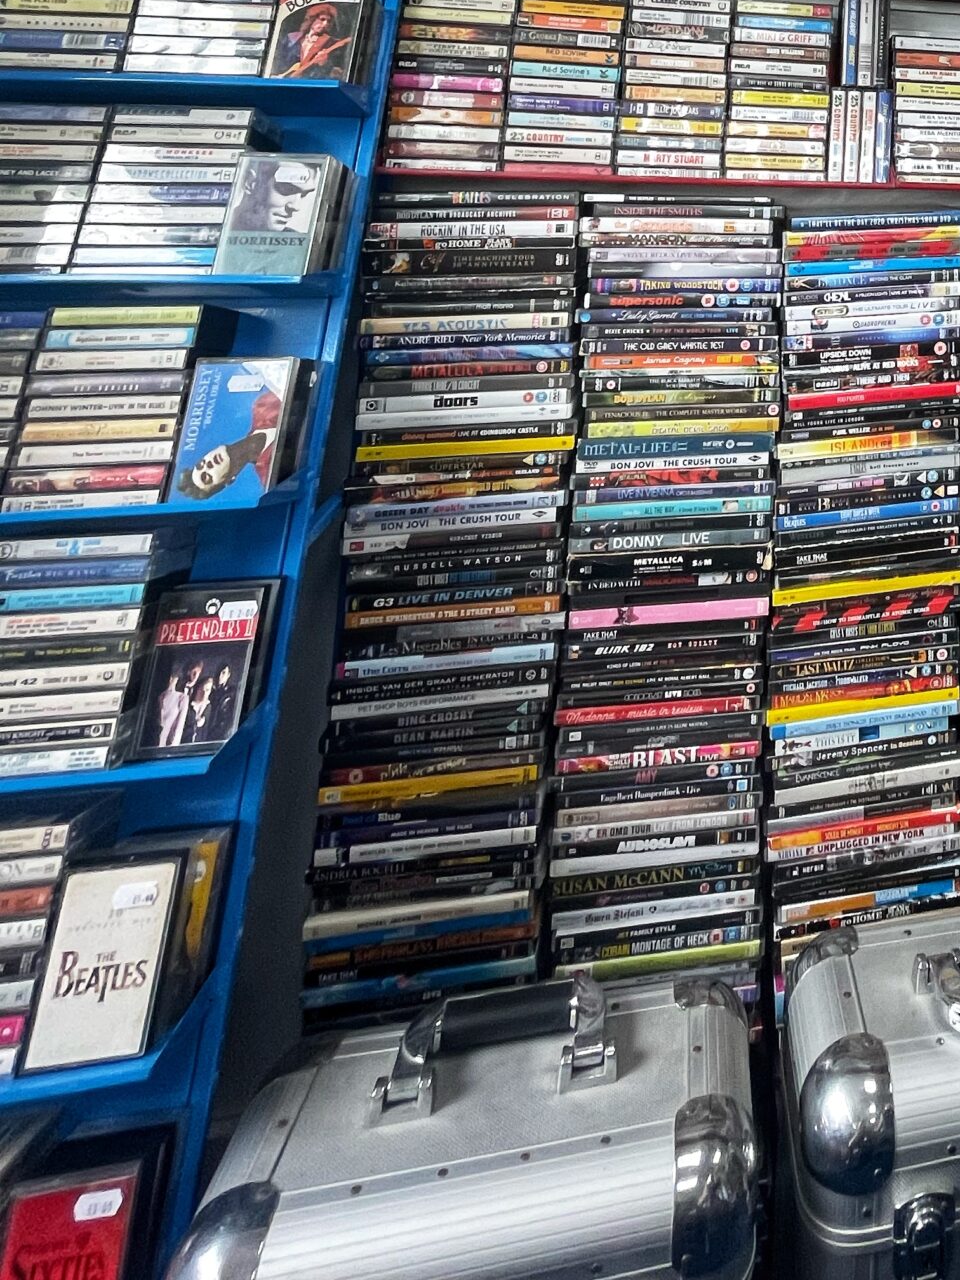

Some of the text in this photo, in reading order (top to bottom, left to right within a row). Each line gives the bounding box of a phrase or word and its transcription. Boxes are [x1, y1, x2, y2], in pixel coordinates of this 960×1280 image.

[679, 0, 711, 8] COUNTRY
[509, 131, 564, 143] 25 COUNTRY
[614, 207, 702, 216] INSIDE THE SMITHS
[420, 224, 506, 237] ROCKIN' IN THE USA
[228, 234, 306, 247] MORRISSEY
[609, 295, 684, 307] supersonic
[623, 340, 724, 350] THE OLD GREY WHISTLE TEST
[433, 395, 479, 408] doors
[183, 367, 214, 452] MORRISSEY
[611, 462, 630, 470] BON
[633, 460, 655, 469] JOVI
[663, 459, 680, 467] THE
[682, 458, 711, 466] CRUSH
[613, 532, 710, 549] DONNY LIVE
[633, 556, 684, 566] METALLICA
[373, 587, 514, 607] G3 LIVE IN DENVER
[160, 620, 240, 643] PRETENDERS
[816, 743, 889, 761] Jeremy Spencer
[616, 835, 696, 854] AUDIOSLAVE
[817, 829, 925, 854] UNPLUGGED IN NEW YORK
[552, 867, 685, 897] SUSAN McCANN
[631, 933, 709, 955] MONTAGE OF HECK
[95, 951, 116, 962] THE
[52, 950, 150, 1004] BEATLES
